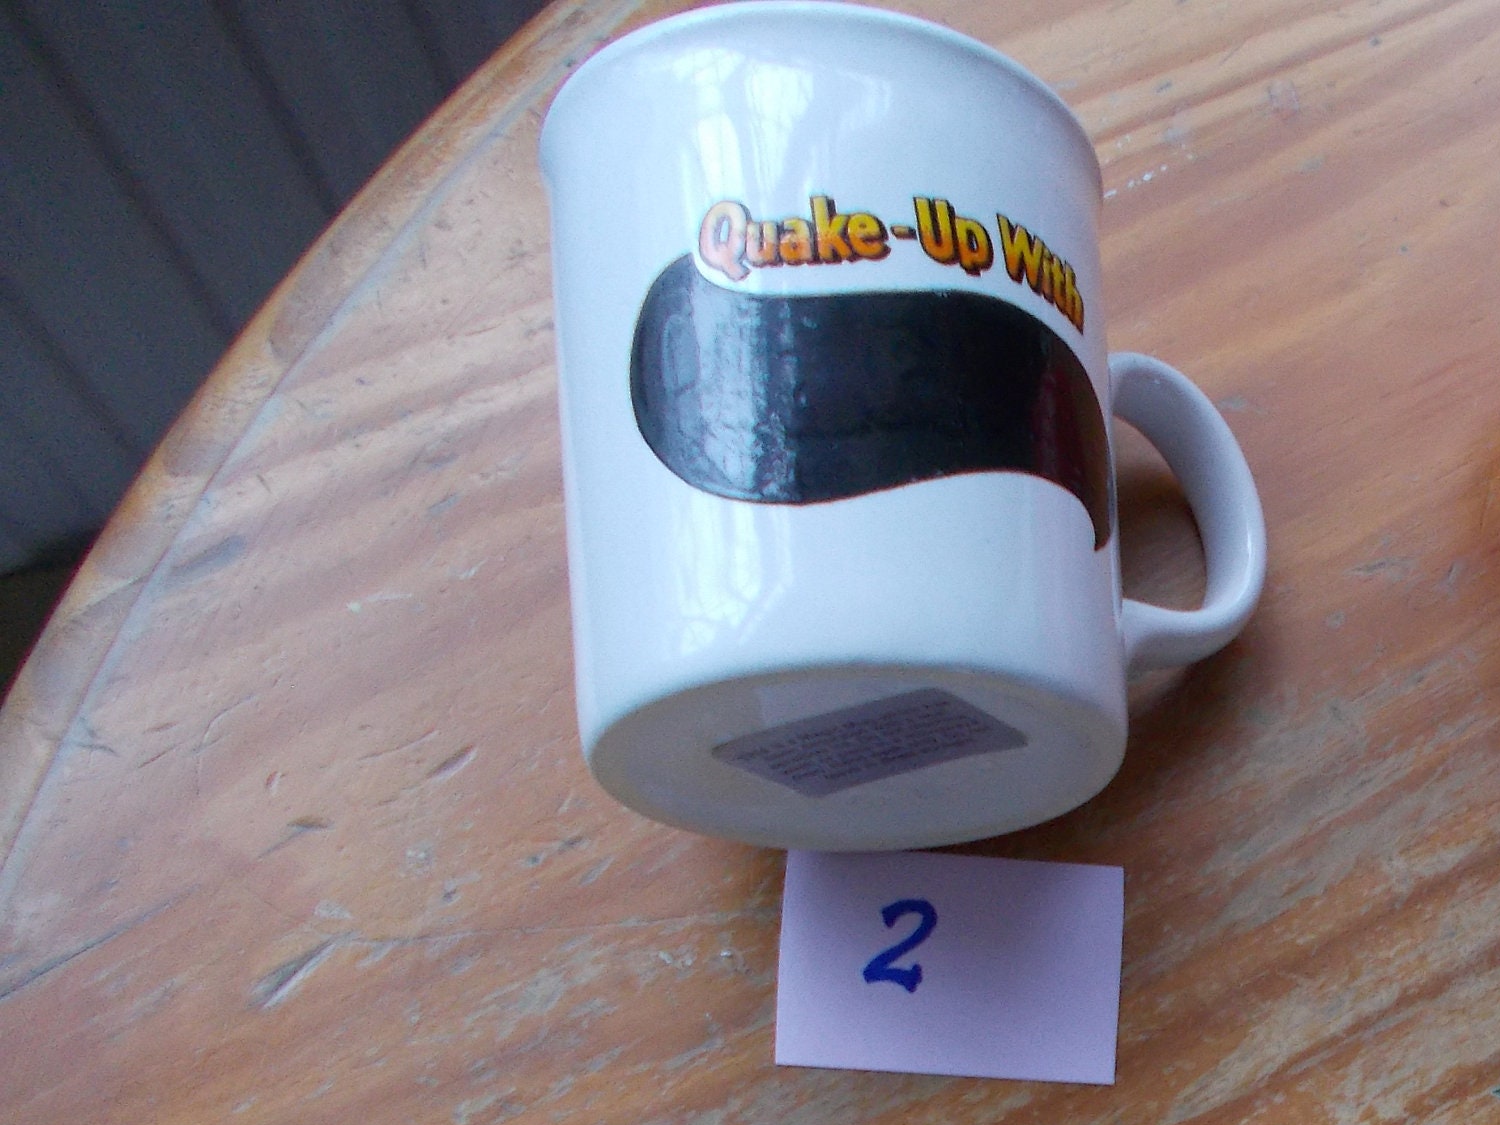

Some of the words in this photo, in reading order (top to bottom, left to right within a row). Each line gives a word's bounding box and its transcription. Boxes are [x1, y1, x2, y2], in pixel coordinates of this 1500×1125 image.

[698, 194, 994, 281] Quake-Up
[996, 212, 1085, 335] With
[862, 898, 938, 993] 2
